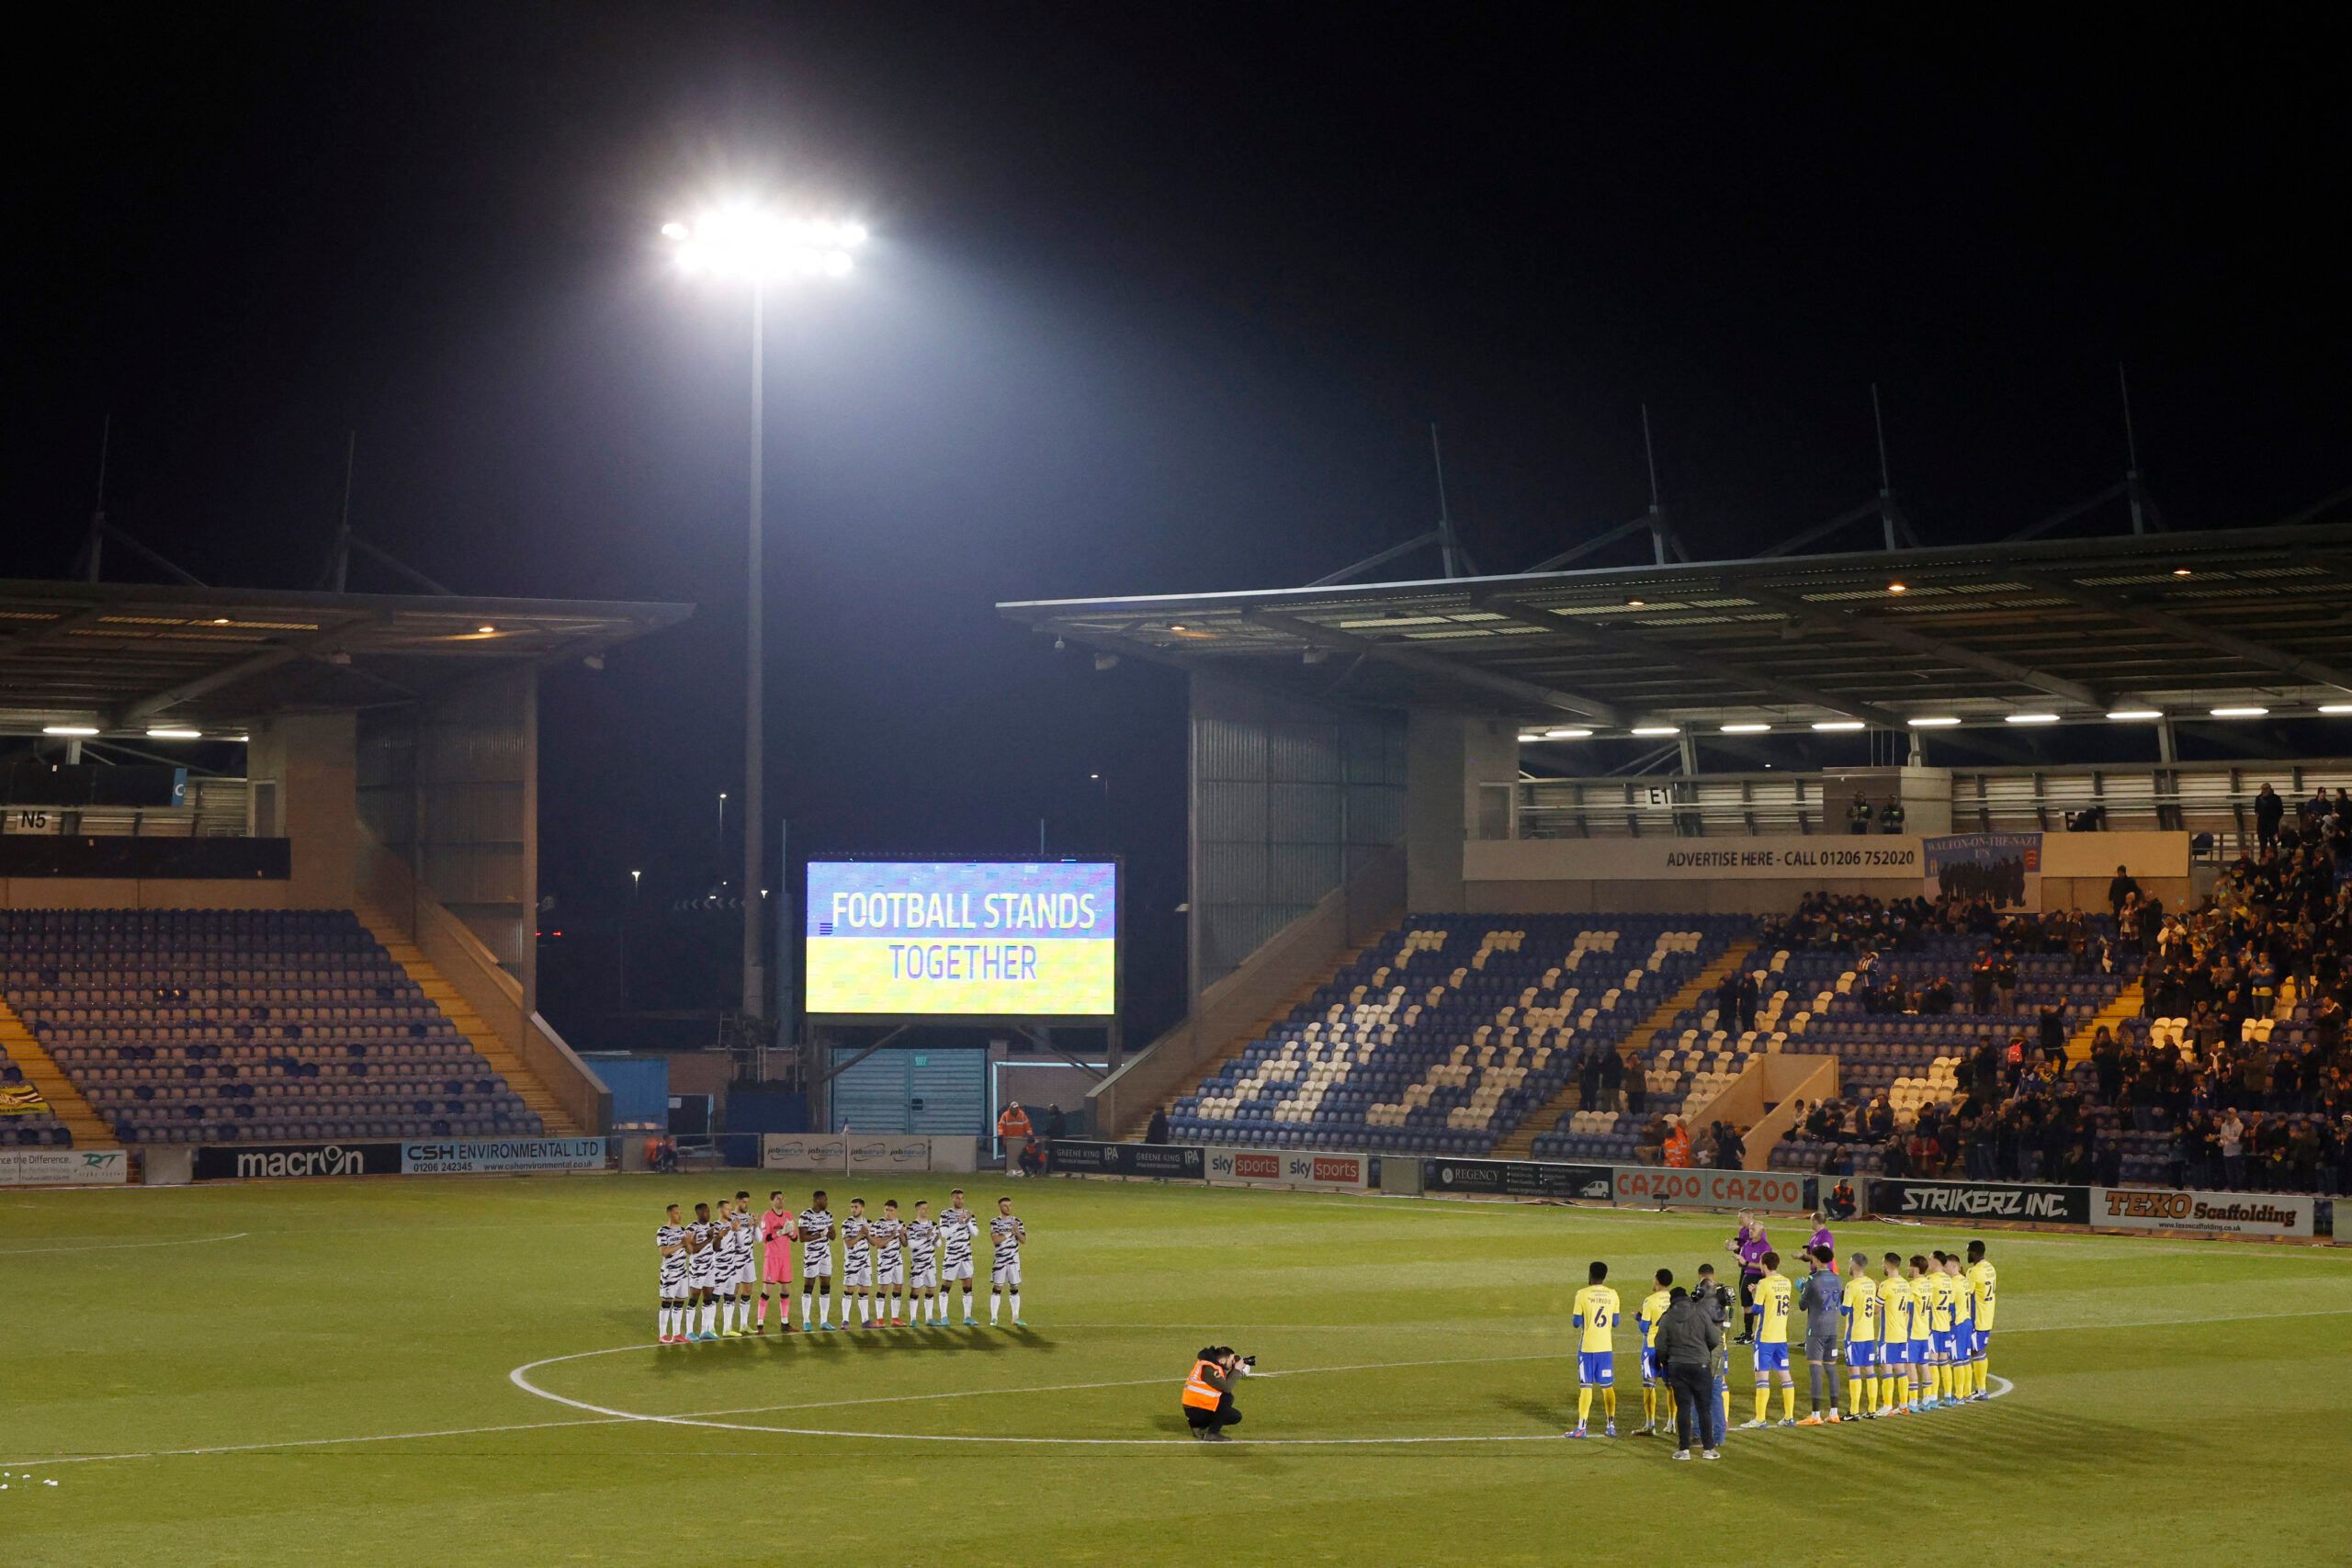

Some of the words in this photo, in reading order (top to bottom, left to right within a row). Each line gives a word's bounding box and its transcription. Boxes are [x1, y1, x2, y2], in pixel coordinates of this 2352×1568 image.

[1649, 786, 1668, 805] E1
[21, 811, 46, 829] N5
[1667, 852, 1737, 866] ADVERTISE
[1741, 852, 1773, 866] HERE
[1784, 851, 1817, 865] CALL
[1820, 851, 1861, 865] 01206
[1864, 851, 1915, 865] 752020
[832, 892, 977, 930] FOOTBALL
[983, 893, 1096, 930] STANDS
[888, 944, 1037, 980] TOGETHER
[407, 1145, 455, 1160] CSH
[458, 1142, 571, 1159] ENVIRONMENTAL
[575, 1141, 599, 1156] LTD
[1057, 1148, 1081, 1157] GREENE
[1083, 1149, 1101, 1158] KING
[1104, 1146, 1119, 1161] IPA
[1136, 1152, 1161, 1162] GREENE
[1162, 1154, 1181, 1163] KING
[1184, 1150, 1200, 1165] IPA
[237, 1145, 364, 1178] macron
[413, 1162, 438, 1172] 01206
[441, 1162, 472, 1171] 242345
[483, 1160, 593, 1170] www.cshenvironmental.co.uk
[1212, 1155, 1233, 1175] sky
[1237, 1158, 1278, 1175] sports
[1290, 1158, 1312, 1179] sky
[1316, 1162, 1358, 1179] sports
[1454, 1168, 1499, 1182] REGENCY
[1617, 1174, 1702, 1198] CAZOO
[1712, 1178, 1799, 1203] CAZOO
[1902, 1188, 2022, 1214] STRIKERZ
[2025, 1193, 2068, 1217] INC.
[2105, 1190, 2193, 1219] TEXO
[2193, 1202, 2297, 1227] Scaffolding
[2159, 1222, 2242, 1232] www.texoscaffolding.co.uk
[1775, 1295, 1790, 1316] 18
[1865, 1297, 1873, 1318] 8
[1594, 1305, 1608, 1327] 6
